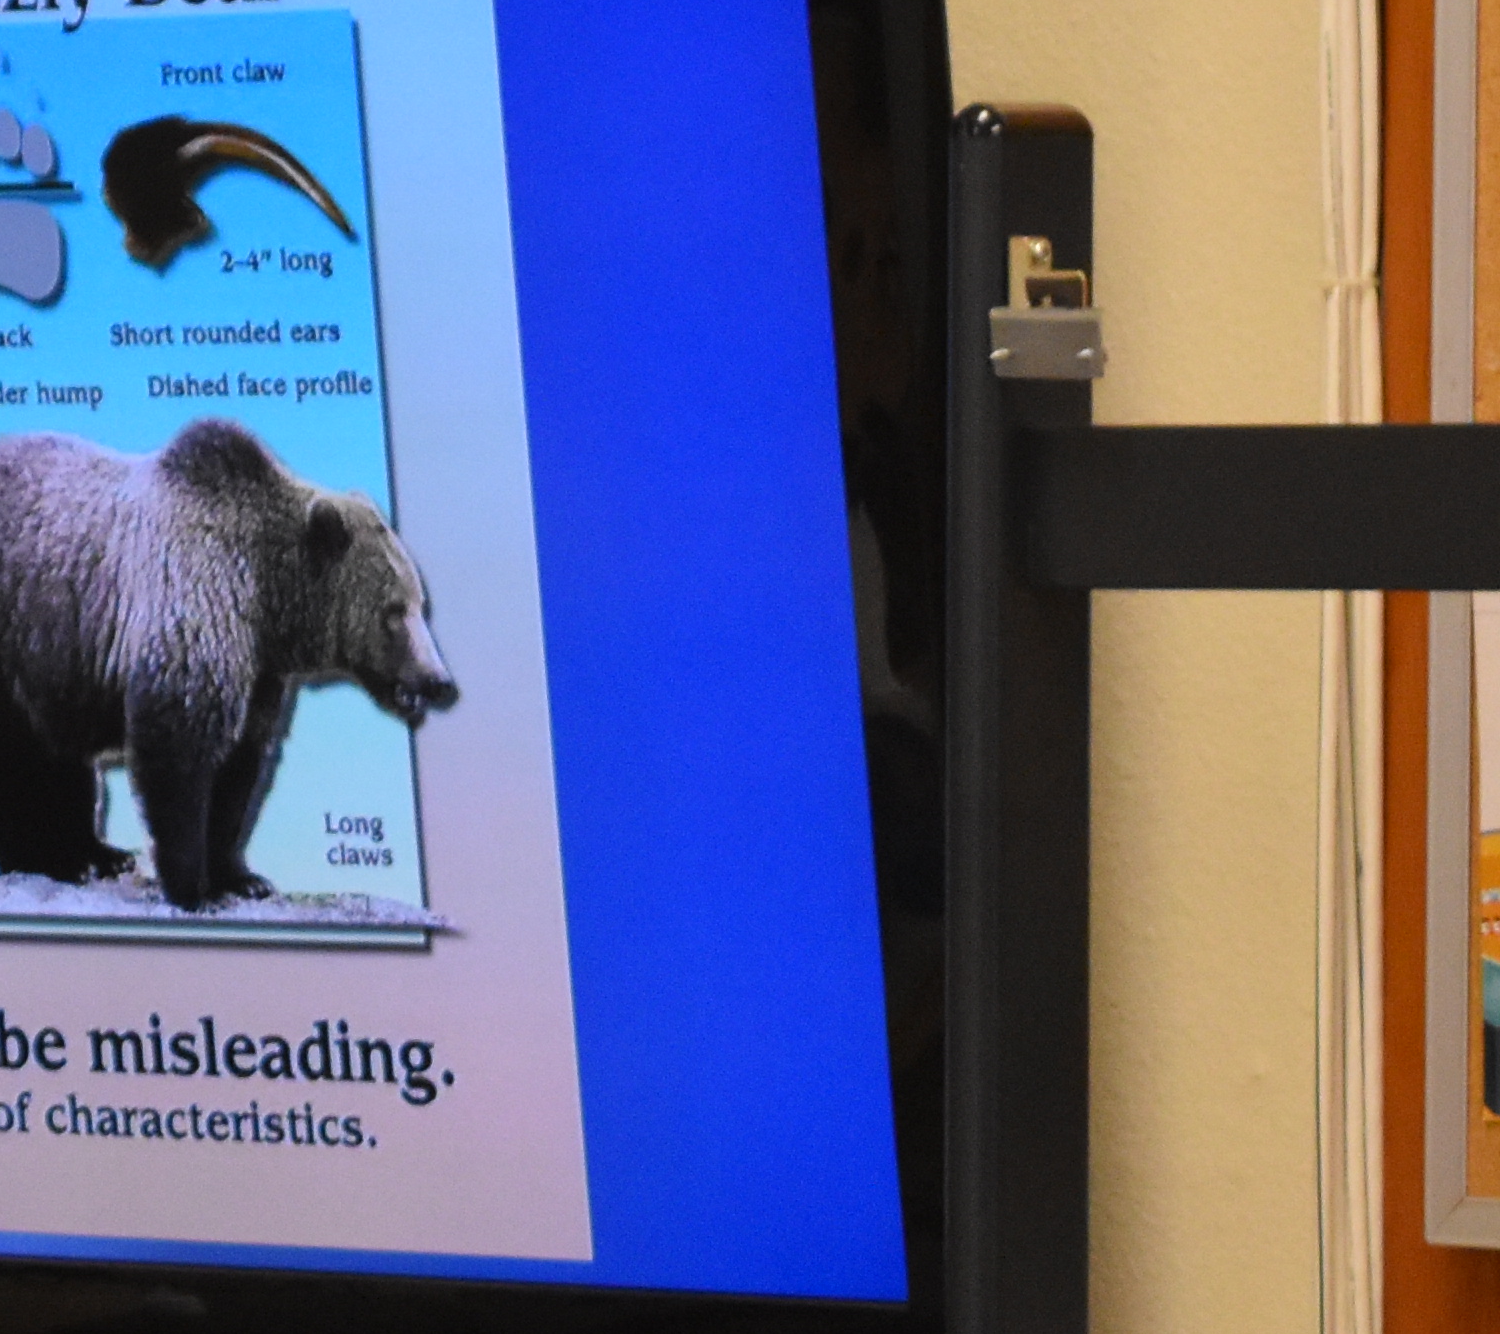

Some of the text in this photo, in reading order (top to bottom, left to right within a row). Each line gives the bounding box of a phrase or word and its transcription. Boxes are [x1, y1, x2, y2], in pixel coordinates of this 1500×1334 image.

[161, 60, 285, 86] Front claw
[280, 247, 333, 278] long
[110, 321, 342, 347] Short rounded ears
[37, 382, 104, 412] hump
[147, 371, 373, 402] Dished face profile
[324, 812, 385, 843] Long
[326, 842, 394, 867] claws
[87, 1013, 456, 1106] misleading.
[45, 1093, 378, 1148] characteristics.
